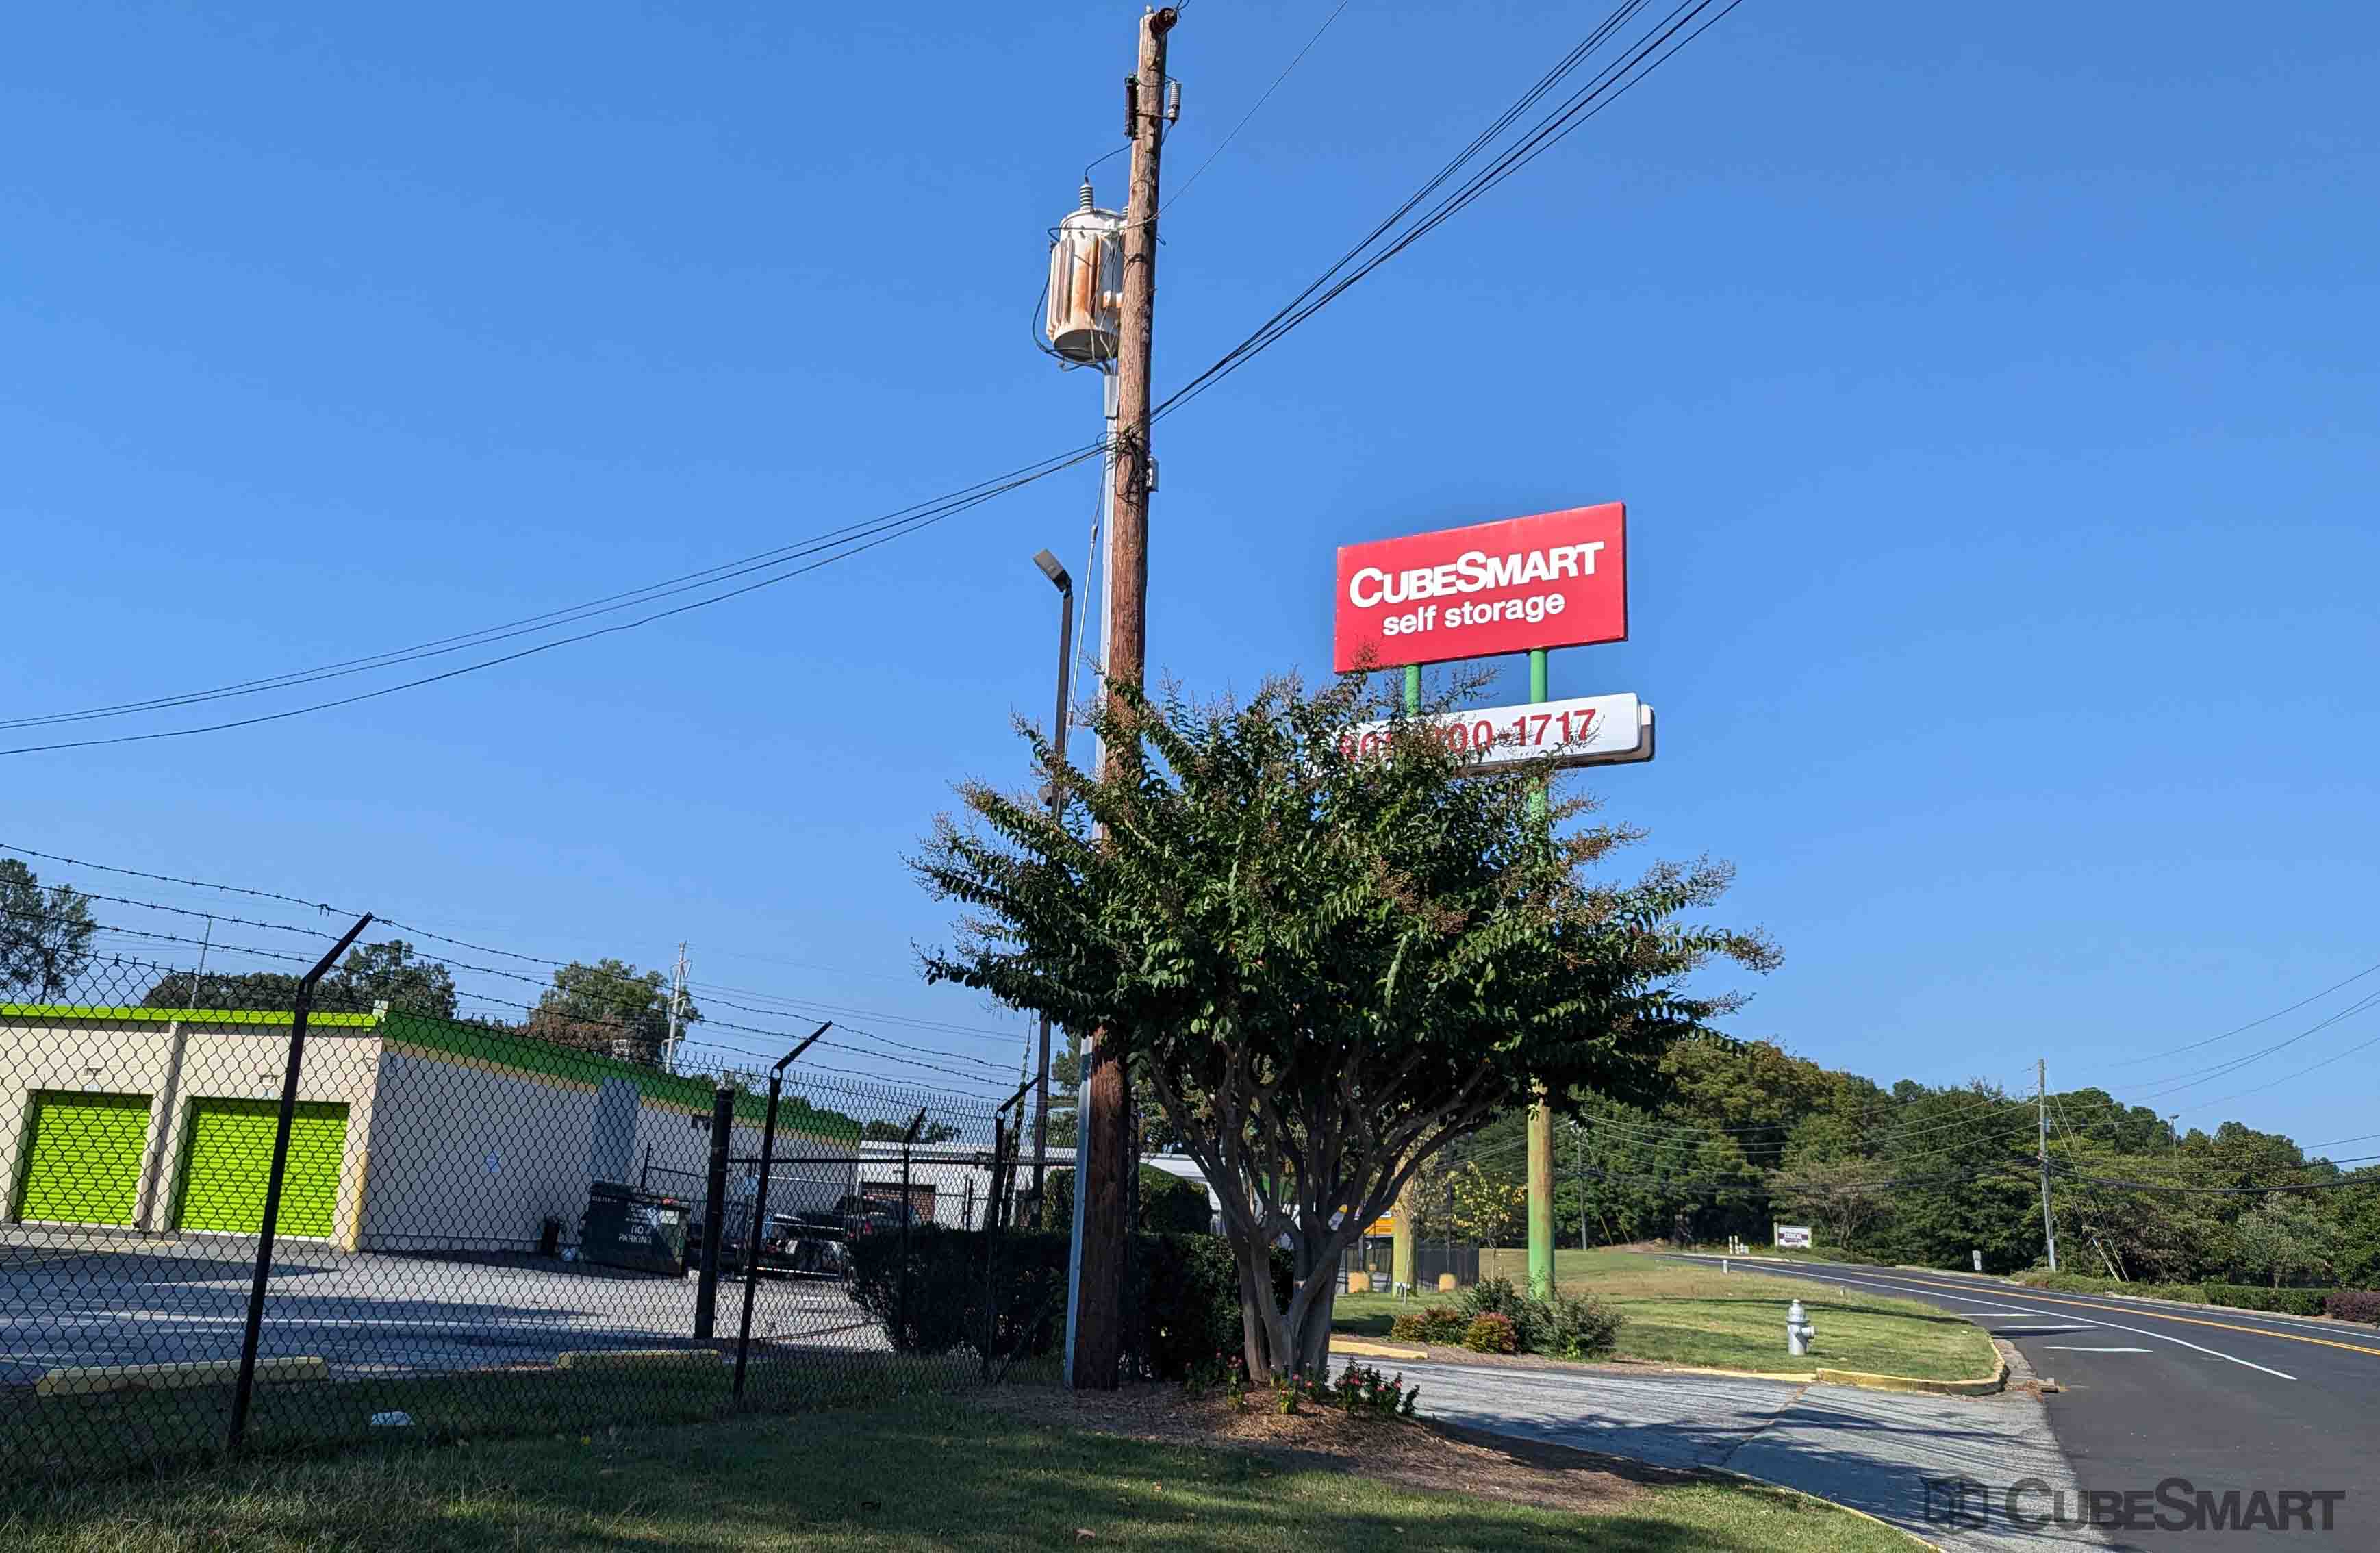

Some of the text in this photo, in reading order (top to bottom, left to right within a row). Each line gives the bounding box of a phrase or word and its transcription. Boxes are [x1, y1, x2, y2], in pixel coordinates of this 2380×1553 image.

[1349, 541, 1604, 608] CUBESMART
[1382, 590, 1566, 636] self storage
